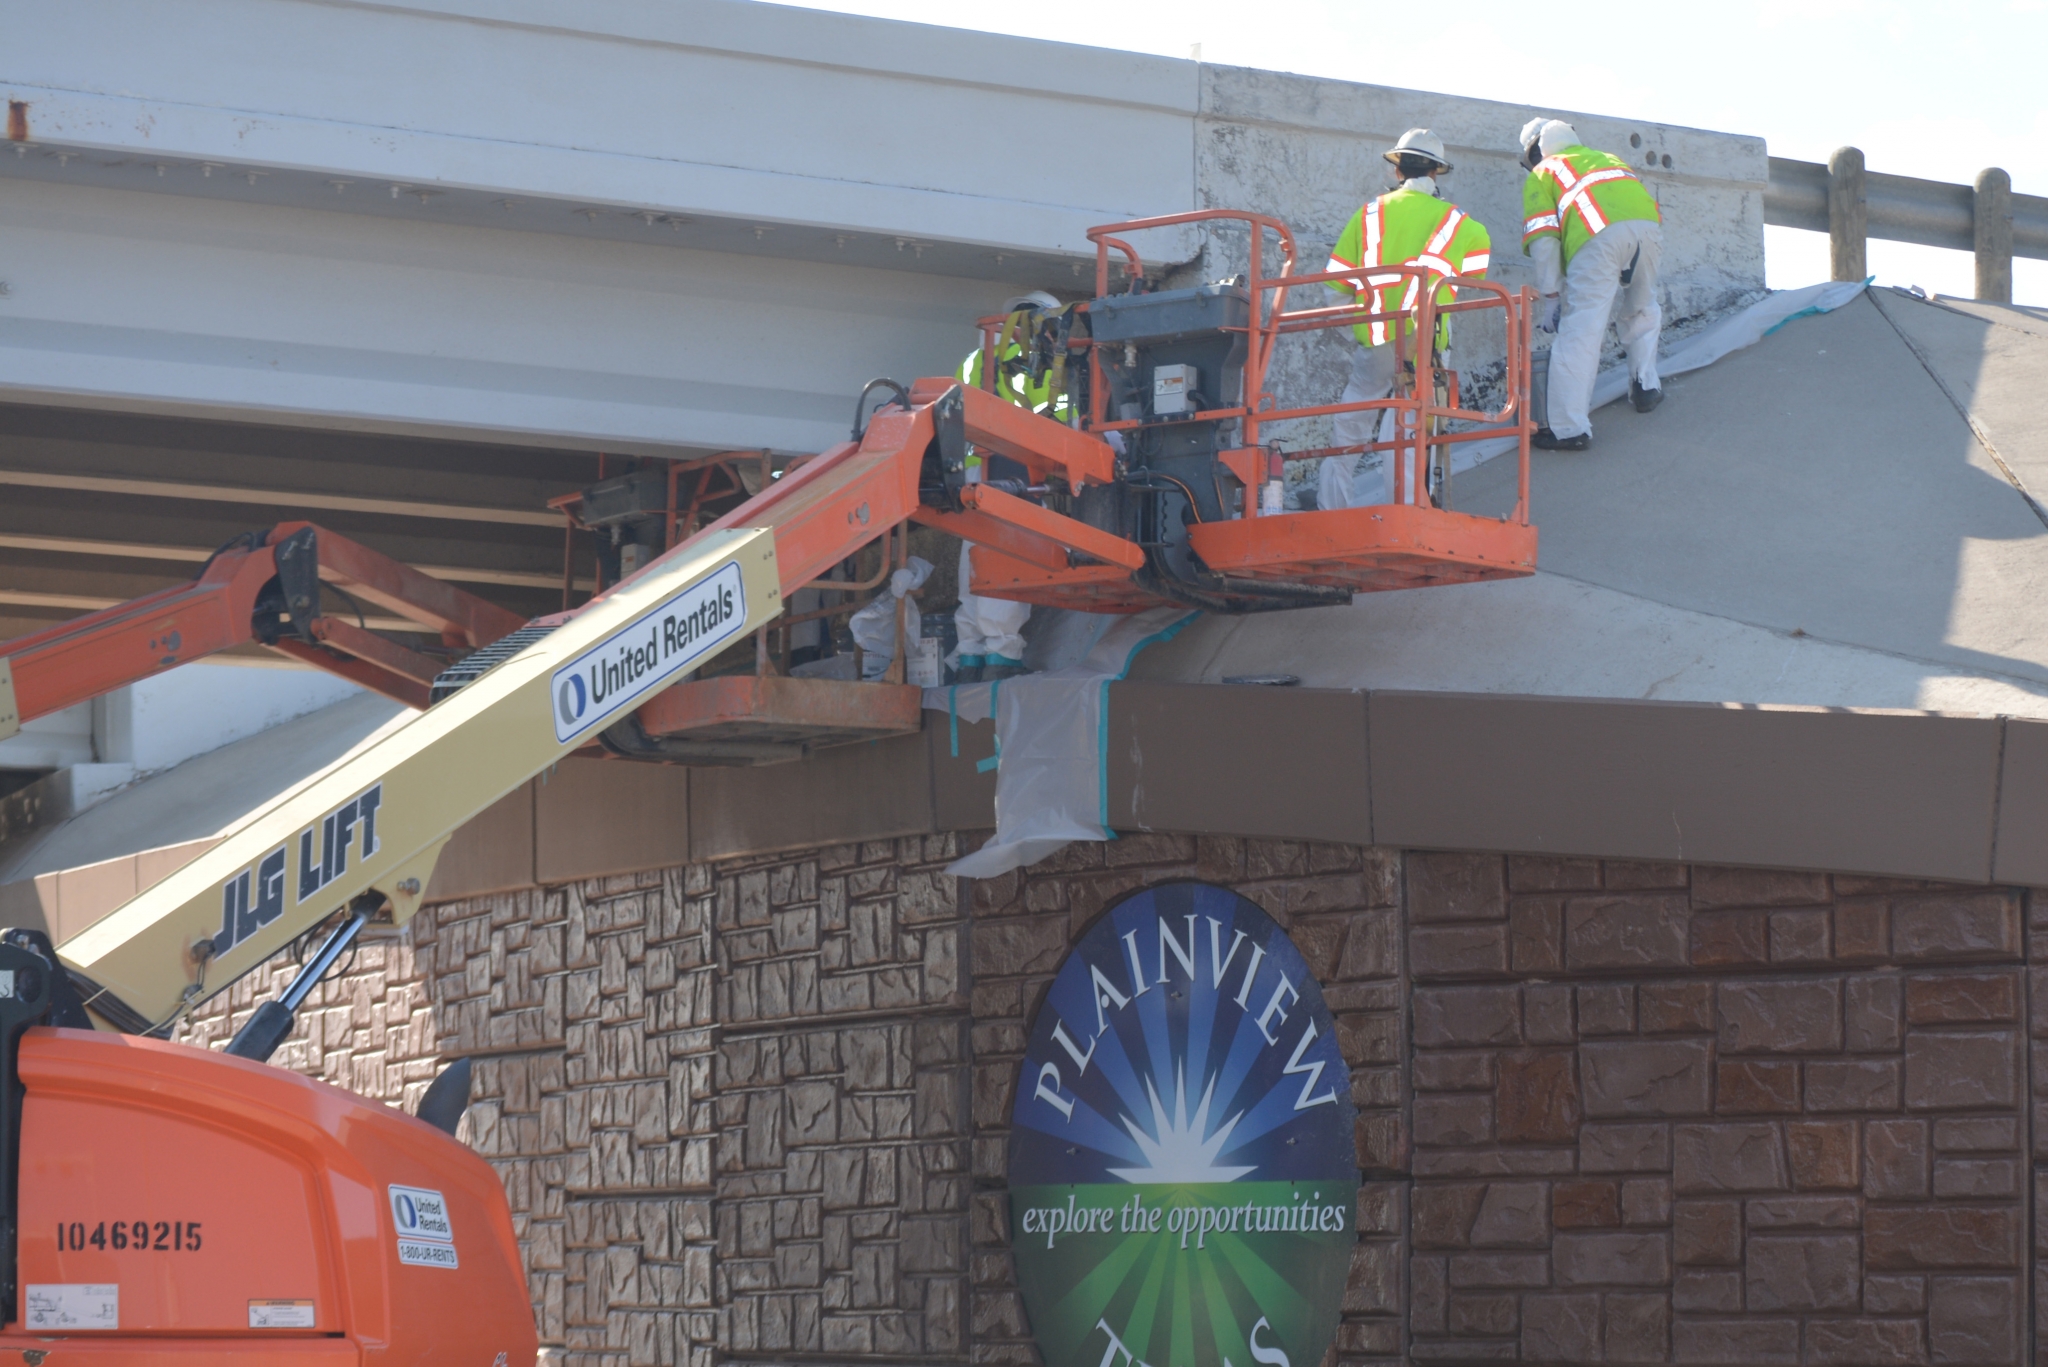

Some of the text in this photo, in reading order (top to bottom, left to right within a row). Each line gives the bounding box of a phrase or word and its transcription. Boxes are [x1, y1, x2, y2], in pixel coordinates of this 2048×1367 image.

[592, 588, 734, 704] United Rentals
[213, 782, 383, 959] JLG LIFT
[1034, 914, 1338, 1124] PLAINVIEW
[415, 1197, 441, 1215] United
[419, 1214, 448, 1233] Rentals
[1022, 1192, 1346, 1250] explore the opportunities
[58, 1221, 202, 1251] 10469215
[400, 1245, 455, 1263] 1-800-UR-RENTS
